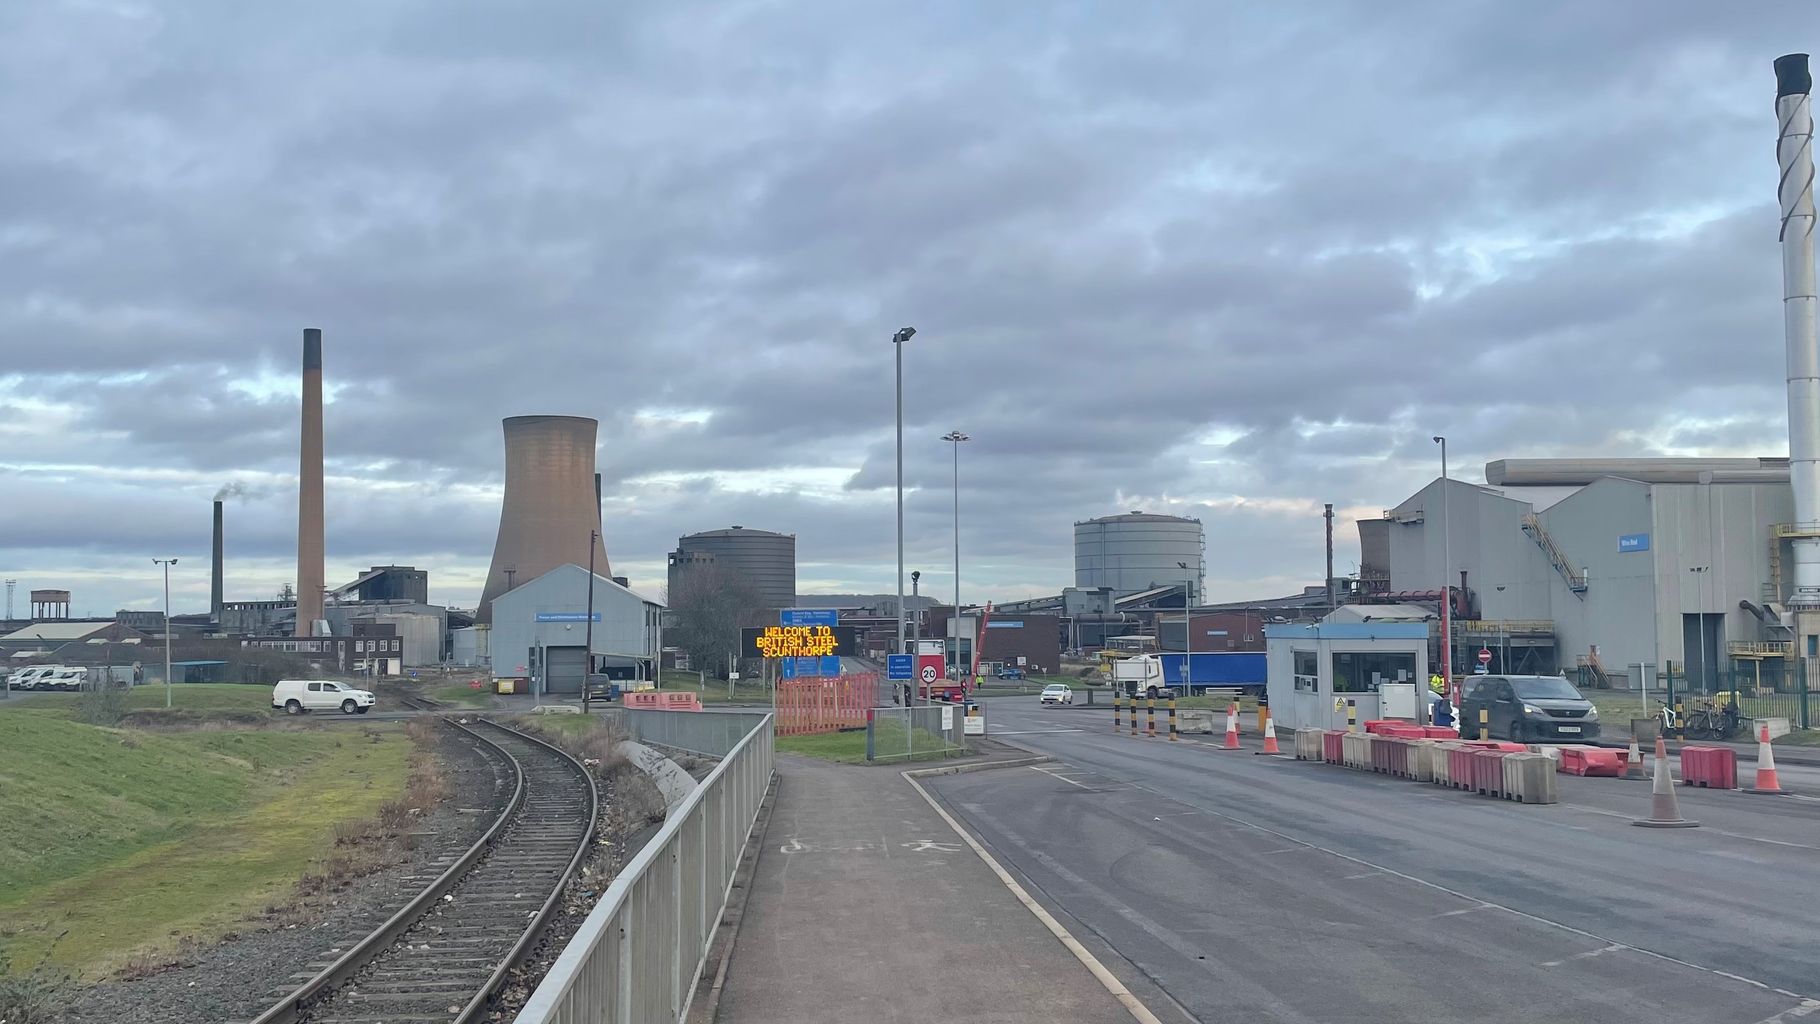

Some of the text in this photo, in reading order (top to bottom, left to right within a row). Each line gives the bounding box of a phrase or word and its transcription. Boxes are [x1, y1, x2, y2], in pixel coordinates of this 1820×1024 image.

[765, 626, 831, 637] WELCOME TO
[756, 635, 839, 648] BRITISH STEEL
[762, 646, 833, 657] SCUNTHORPE
[923, 669, 935, 678] 20
